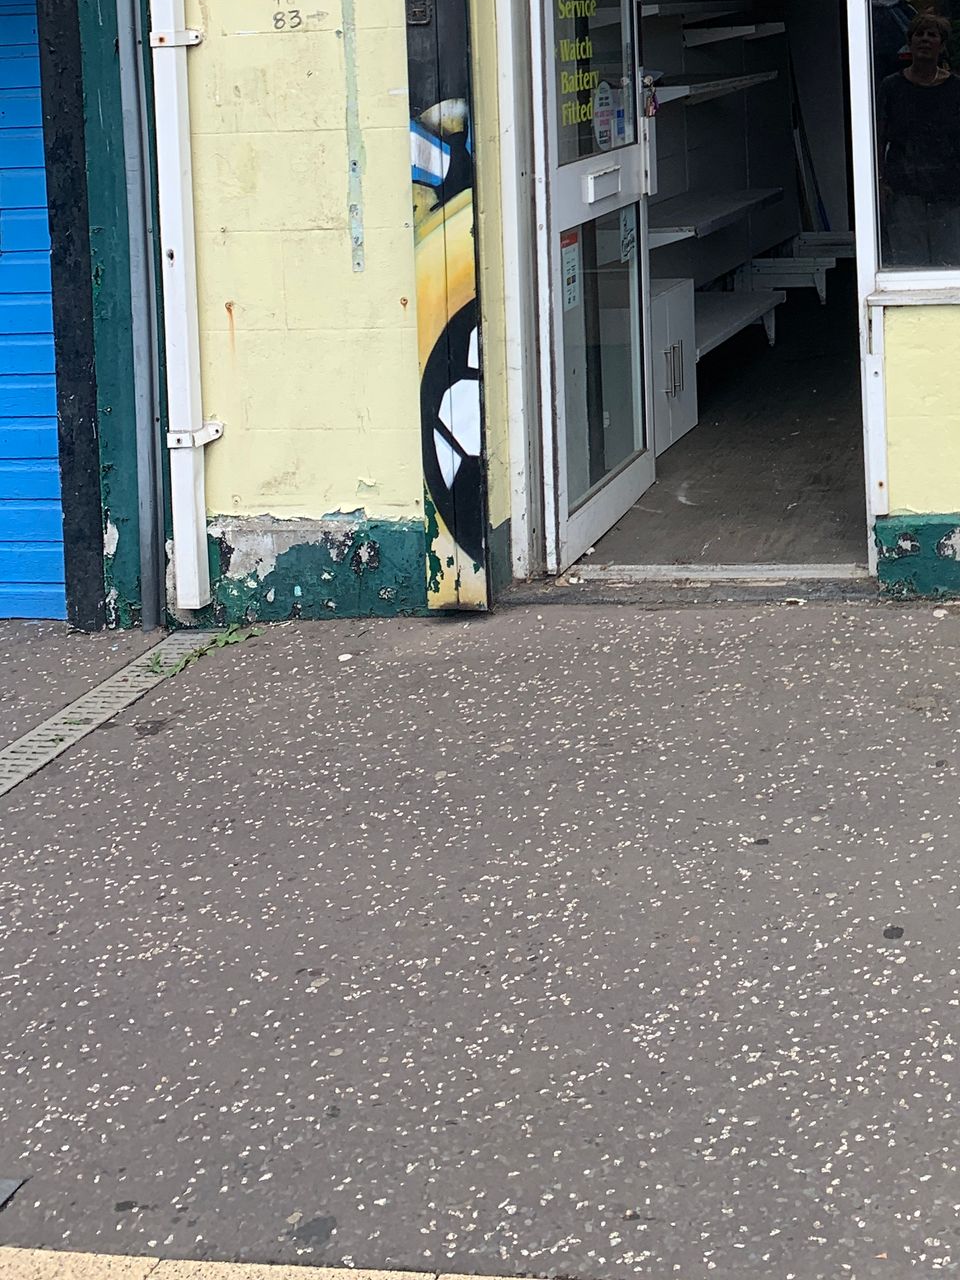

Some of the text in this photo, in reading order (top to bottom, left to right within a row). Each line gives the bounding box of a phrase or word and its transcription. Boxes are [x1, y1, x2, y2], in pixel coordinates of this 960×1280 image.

[272, 9, 302, 30] 83
[560, 36, 593, 62] Watch
[561, 69, 599, 94] Battery
[562, 98, 594, 127] Fitted
